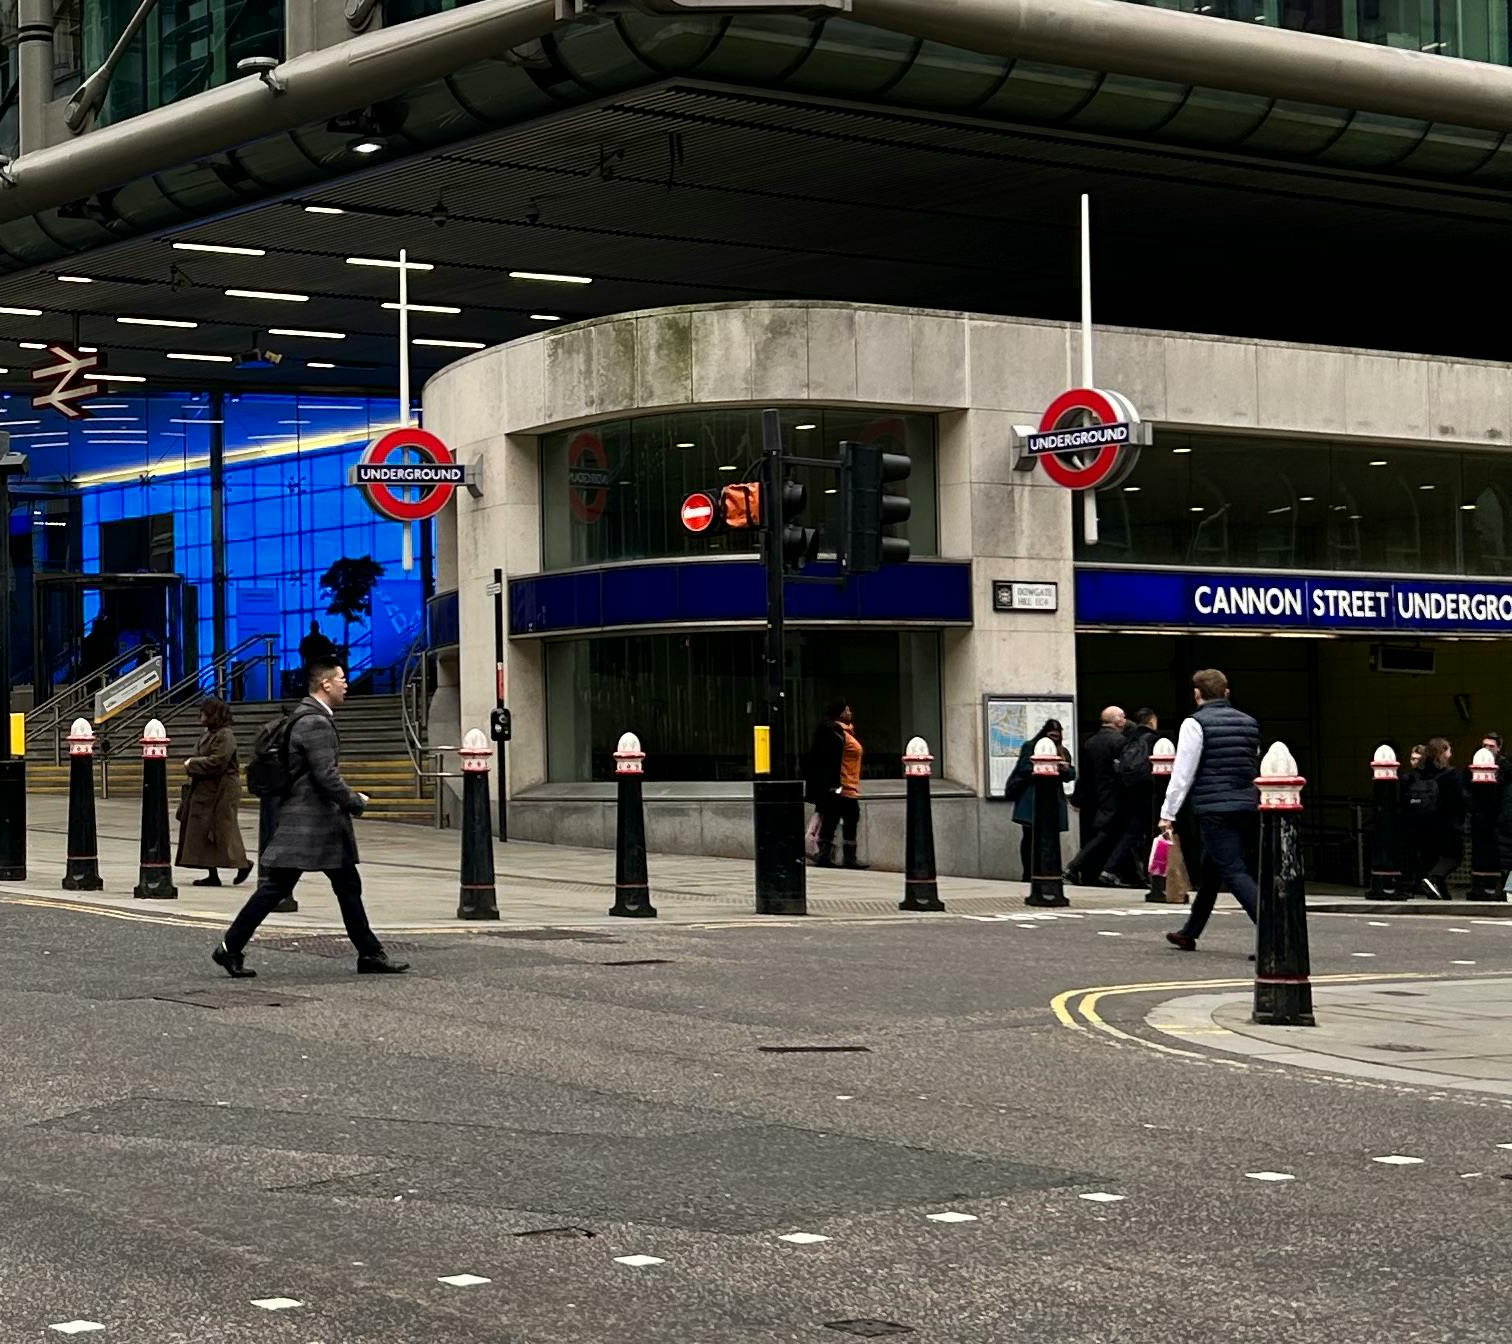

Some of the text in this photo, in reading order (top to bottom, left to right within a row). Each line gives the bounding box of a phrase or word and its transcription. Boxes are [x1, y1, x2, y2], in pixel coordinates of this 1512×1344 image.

[1029, 427, 1128, 451] UNDERGROUND
[360, 468, 461, 480] UNDERGROUND
[1194, 585, 1512, 621] CANNON STREET UNDERGRO
